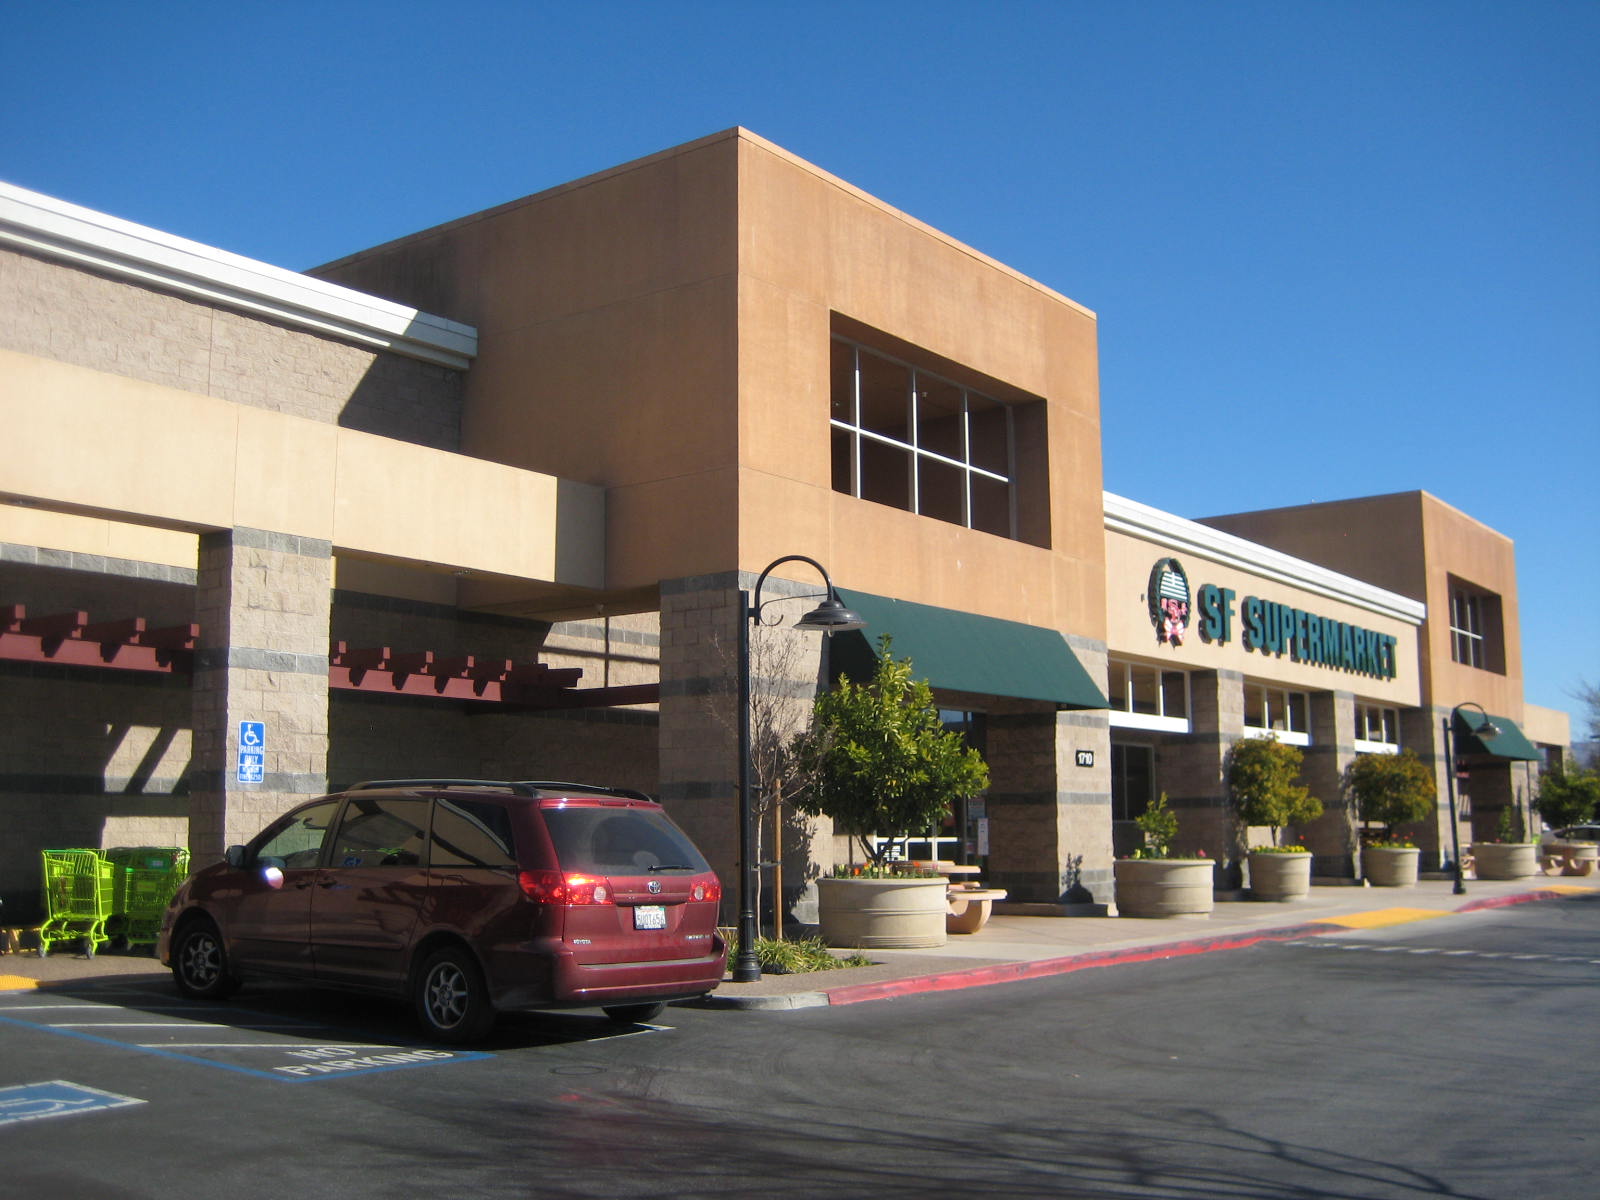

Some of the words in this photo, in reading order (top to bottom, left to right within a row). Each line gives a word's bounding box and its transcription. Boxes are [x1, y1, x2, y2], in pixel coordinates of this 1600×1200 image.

[1198, 583, 1236, 645] SF
[1241, 595, 1398, 681] SUPERMARKET
[240, 745, 264, 754] PARKING
[1078, 752, 1093, 765] 1710
[272, 1050, 454, 1076] PARKING
